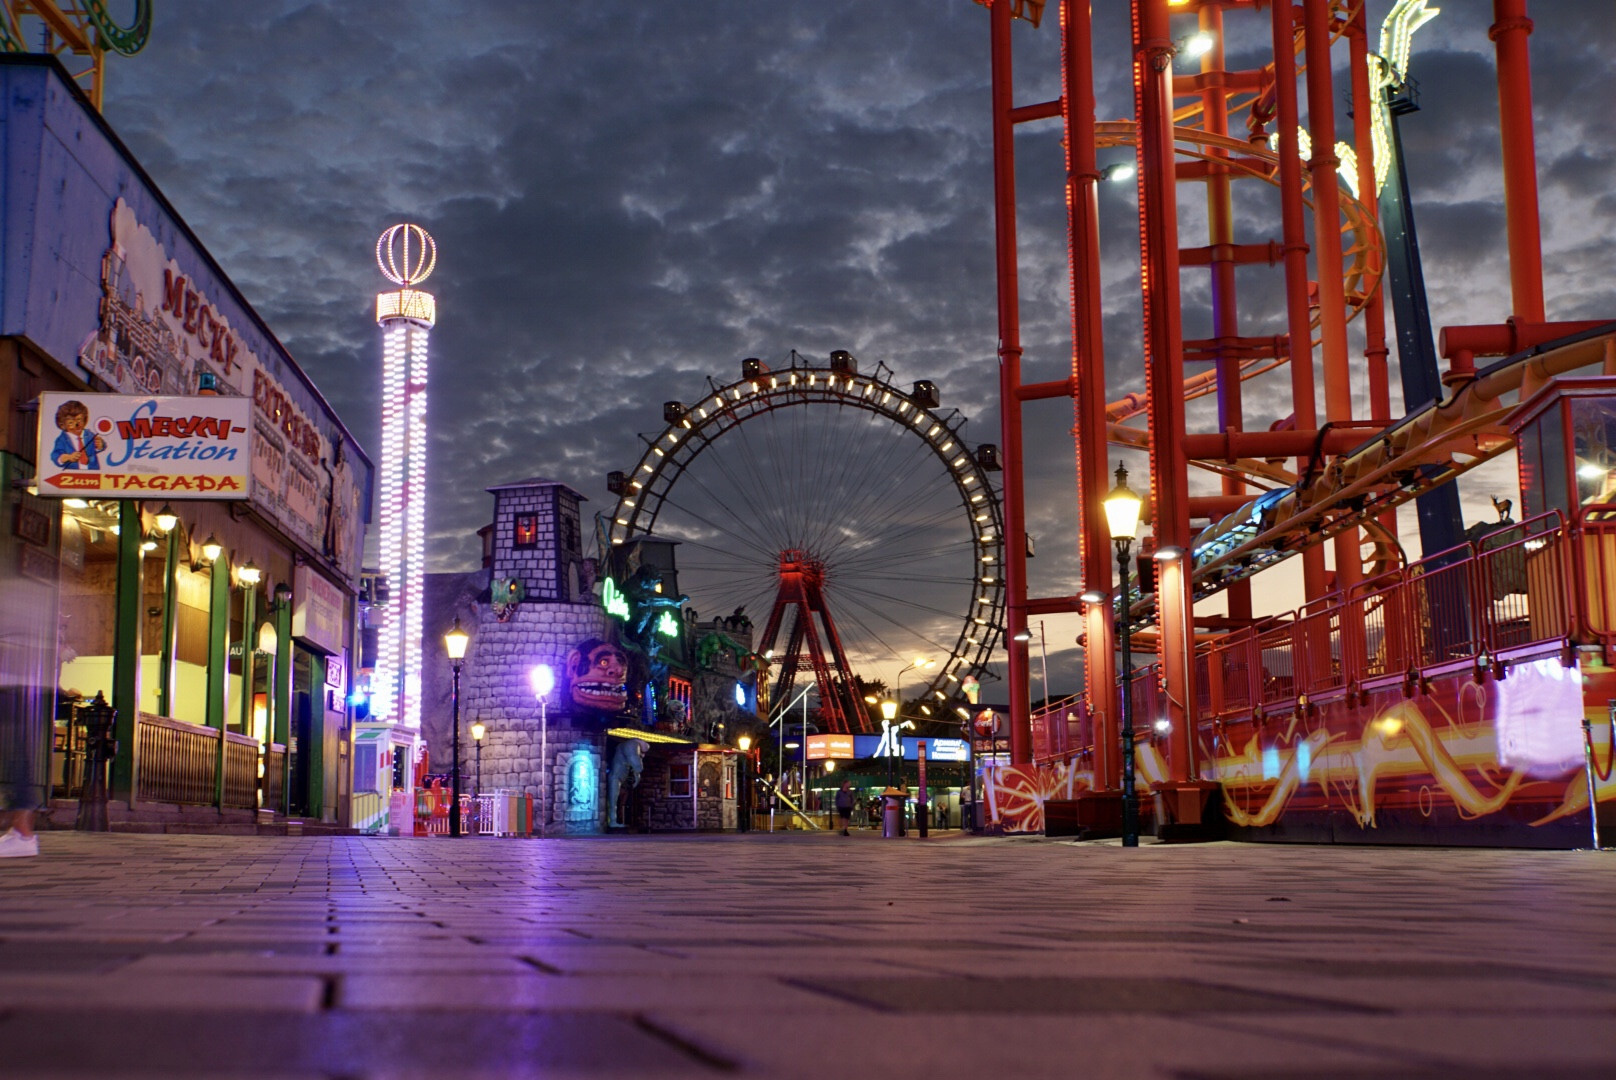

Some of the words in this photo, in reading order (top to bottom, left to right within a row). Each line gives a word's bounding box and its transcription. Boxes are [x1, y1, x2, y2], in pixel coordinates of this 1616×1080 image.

[106, 400, 238, 467] Station
[254, 368, 321, 466] EXPRESS
[60, 475, 99, 486] Zum
[104, 474, 240, 491] TAGADA
